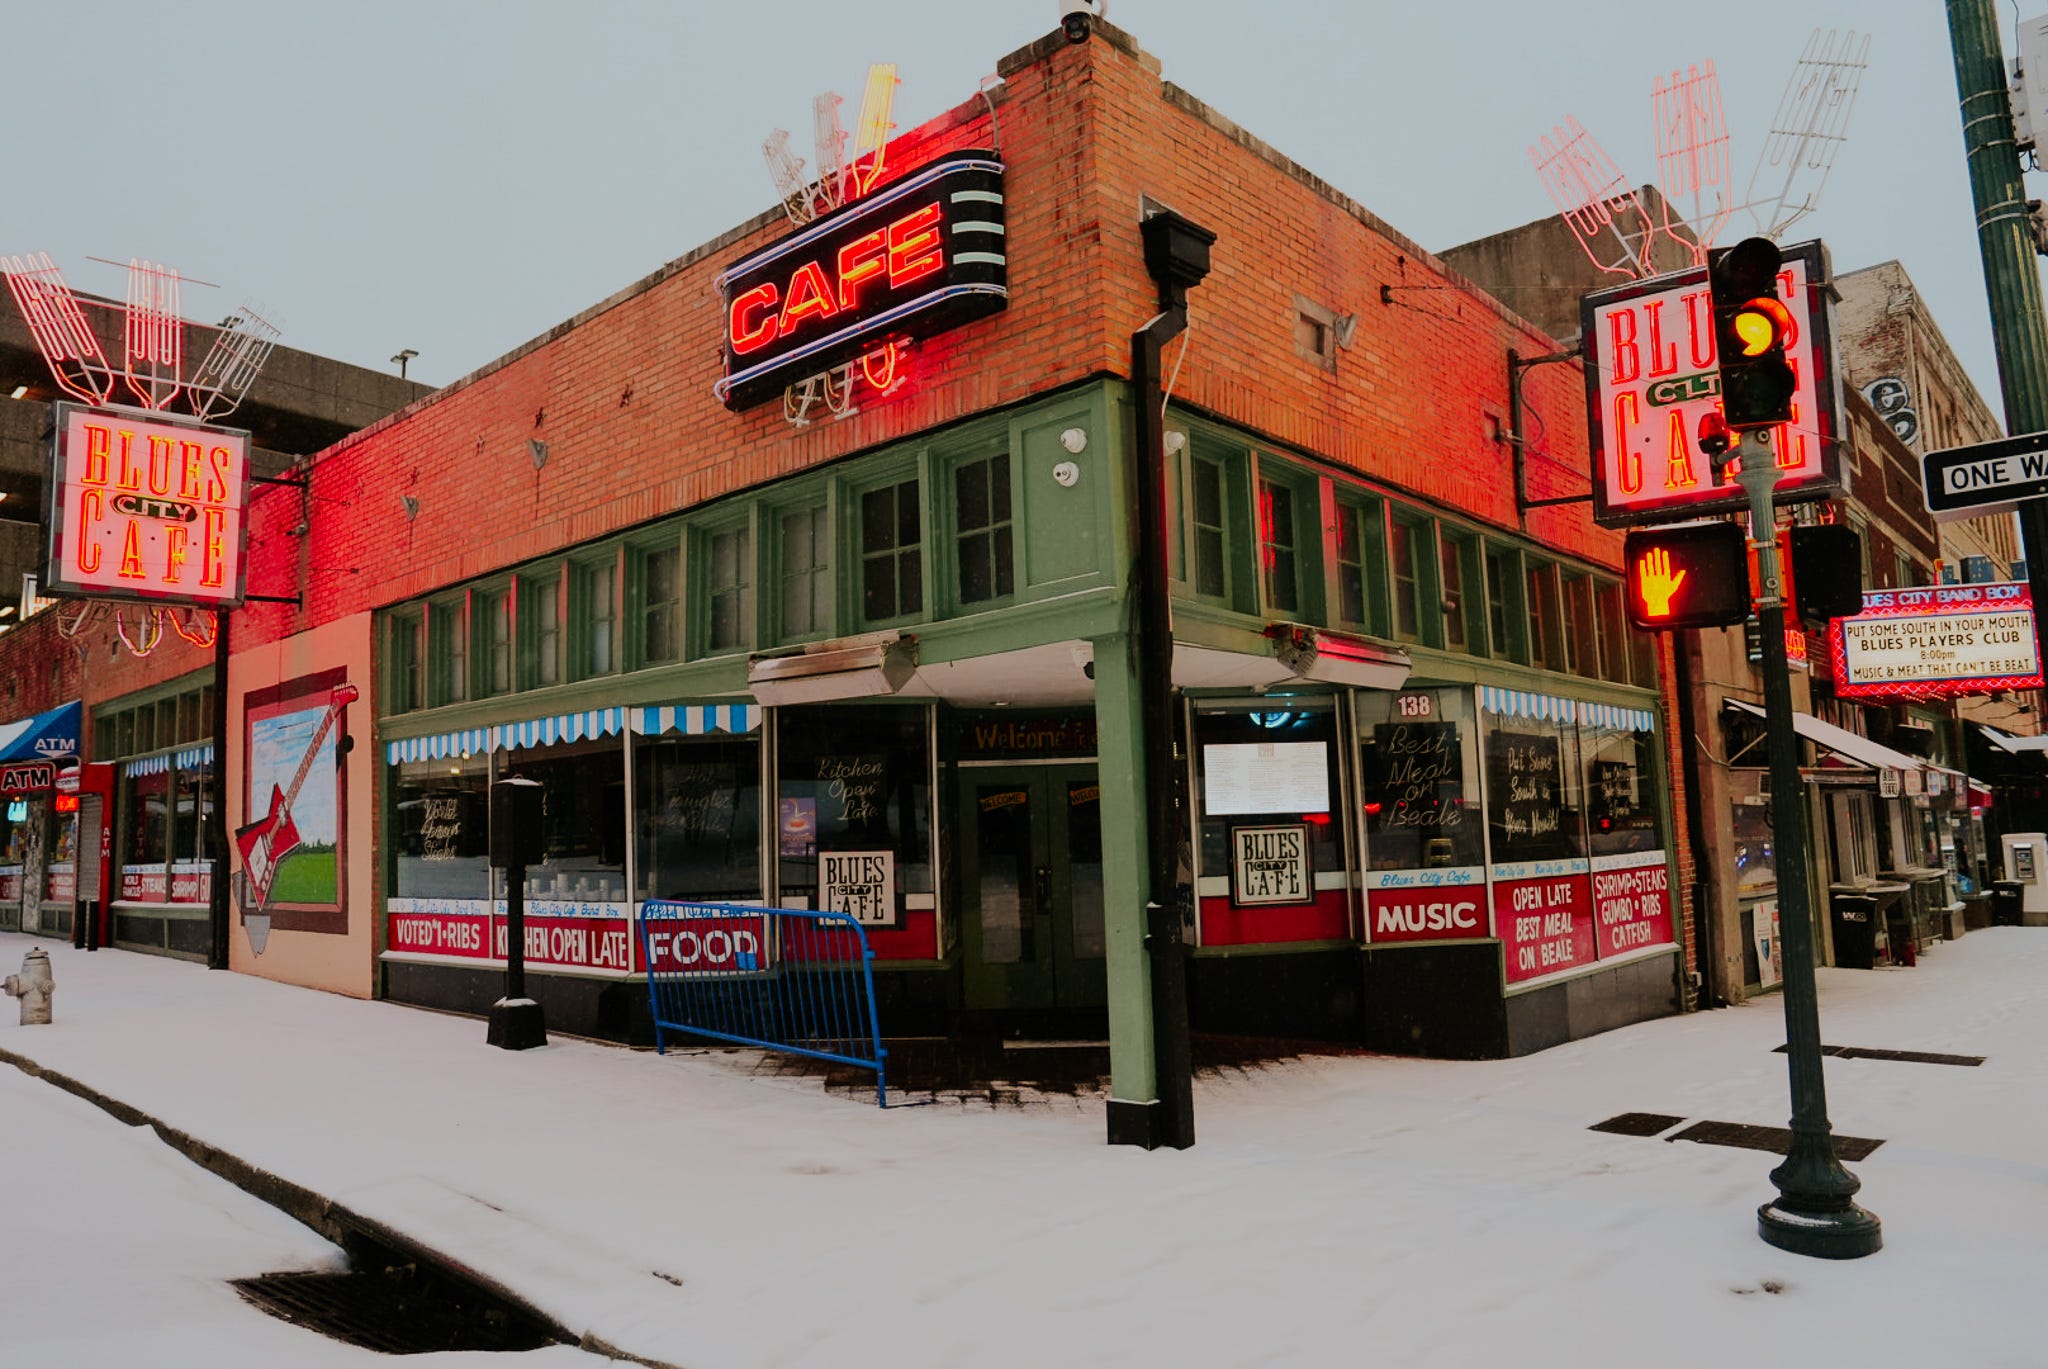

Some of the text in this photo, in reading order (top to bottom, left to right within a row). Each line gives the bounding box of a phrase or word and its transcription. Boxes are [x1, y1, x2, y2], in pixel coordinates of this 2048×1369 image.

[731, 201, 943, 355] CAFE
[1606, 269, 1801, 386] BLU
[1654, 374, 1722, 402] CIT
[1614, 358, 1806, 497] CAE
[81, 423, 231, 503] BLUES
[1951, 453, 2048, 490] ONE W
[117, 496, 192, 521] CITY
[78, 489, 226, 587] CAFE
[1862, 586, 2020, 608] UES CITY BAND BOX
[1847, 616, 2029, 637] PUT SOME SOUTH IN YOUR MOUTH
[1861, 631, 2020, 651] BLUES PLAYERS CLUB
[1854, 659, 2029, 679] MUSIC & MEAT THAT CAN'T BE BEAT
[1920, 650, 1955, 660] 8:00pm
[1398, 696, 1430, 715] 138
[34, 738, 75, 750] ATM
[976, 721, 1066, 750] Welcome
[1387, 726, 1447, 754] Best
[1, 767, 50, 791] ATM
[817, 757, 883, 778] Kitchen
[1385, 747, 1452, 790] Meal
[828, 779, 877, 802] Open
[1405, 781, 1434, 801] on
[1386, 798, 1462, 829] Beale
[101, 826, 111, 858] ATM
[1242, 832, 1299, 861] BLUES
[826, 856, 885, 885] BLUES
[1420, 872, 1443, 887] City
[838, 885, 871, 895] CITY
[1513, 883, 1573, 911] OPEN LATE
[1377, 902, 1477, 932] MUSIC
[1602, 893, 1662, 925] GUMBO RIBS
[397, 919, 433, 946] VOTED
[1516, 912, 1573, 942] BEST MEAL
[1612, 920, 1651, 950] CATFISH
[497, 925, 627, 967] KIHEN OPEN LATE
[649, 930, 759, 965] FOOD
[1519, 939, 1573, 970] ON BEALE
